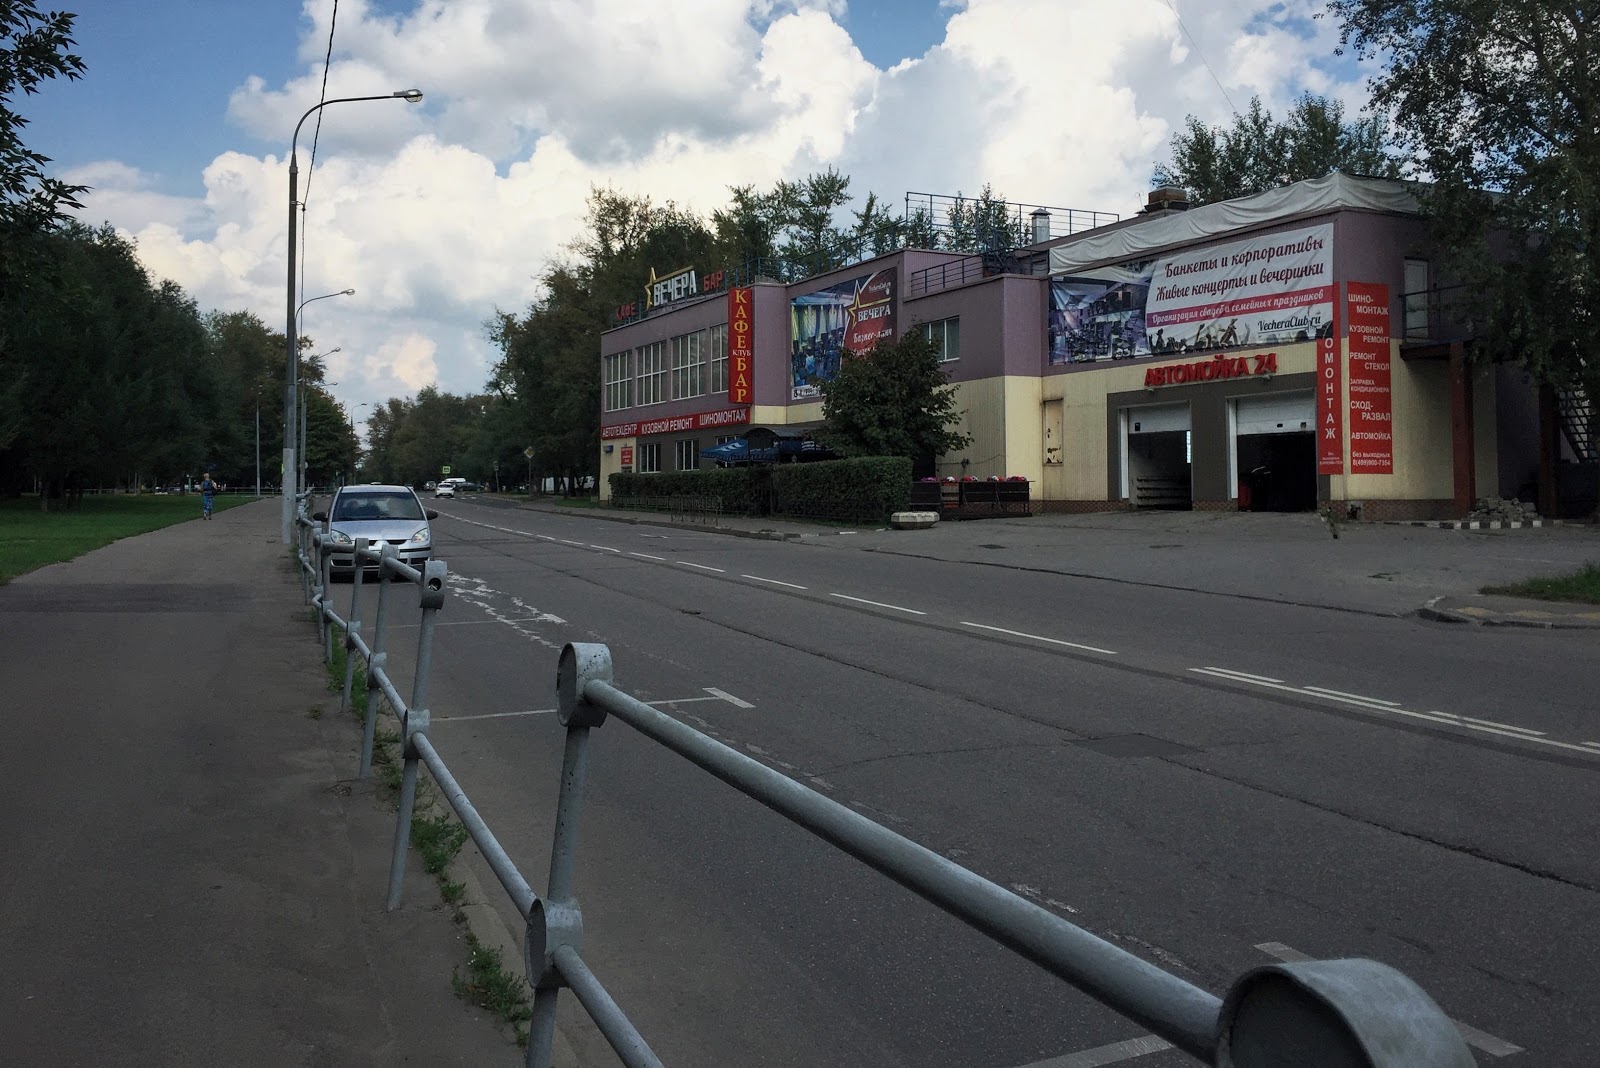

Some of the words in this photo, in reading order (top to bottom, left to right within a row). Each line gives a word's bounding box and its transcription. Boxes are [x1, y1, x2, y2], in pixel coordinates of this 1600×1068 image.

[1165, 258, 1218, 278] Банкеты
[1221, 256, 1228, 268] и
[1231, 236, 1323, 268] корпоративы
[653, 270, 697, 307] ВЕЧЕРА
[704, 271, 725, 292] БАР
[1156, 284, 1189, 301] Живые
[1191, 276, 1248, 297] концерты
[1250, 274, 1257, 286] и
[1260, 263, 1324, 285] вечеринки
[1348, 293, 1374, 304] ШИНО-
[857, 304, 891, 322] ВЕЧЕРА
[1152, 310, 1198, 325] Организация
[1199, 306, 1225, 318] свадеб
[1231, 299, 1271, 312] семейных
[1273, 290, 1324, 307] праздников
[1356, 305, 1389, 315] МОНТАЖ
[1349, 324, 1384, 334] КУЗОВНОЙ
[1362, 335, 1389, 344] РЕМОНТ
[1349, 351, 1377, 360] РЕМОНТ
[1144, 354, 1249, 387] АВТОМОЙКА
[1254, 353, 1277, 375] 24
[1364, 362, 1390, 371] СТЕКОЛ
[1324, 337, 1336, 439] ОМОНТАЖ
[1349, 378, 1375, 386] ЗАПРАВКА
[1350, 400, 1374, 411] СХОД-
[699, 408, 747, 426] ШИНОМОНТАЖ
[1361, 411, 1391, 421] РАЗВАЛ
[602, 423, 638, 437] АВТОТЕХЦЕНТР
[641, 418, 669, 435] КУЗОВНОЙ
[669, 417, 693, 432] РЕМОНТ
[1351, 431, 1391, 440] АВТОМОЙКА
